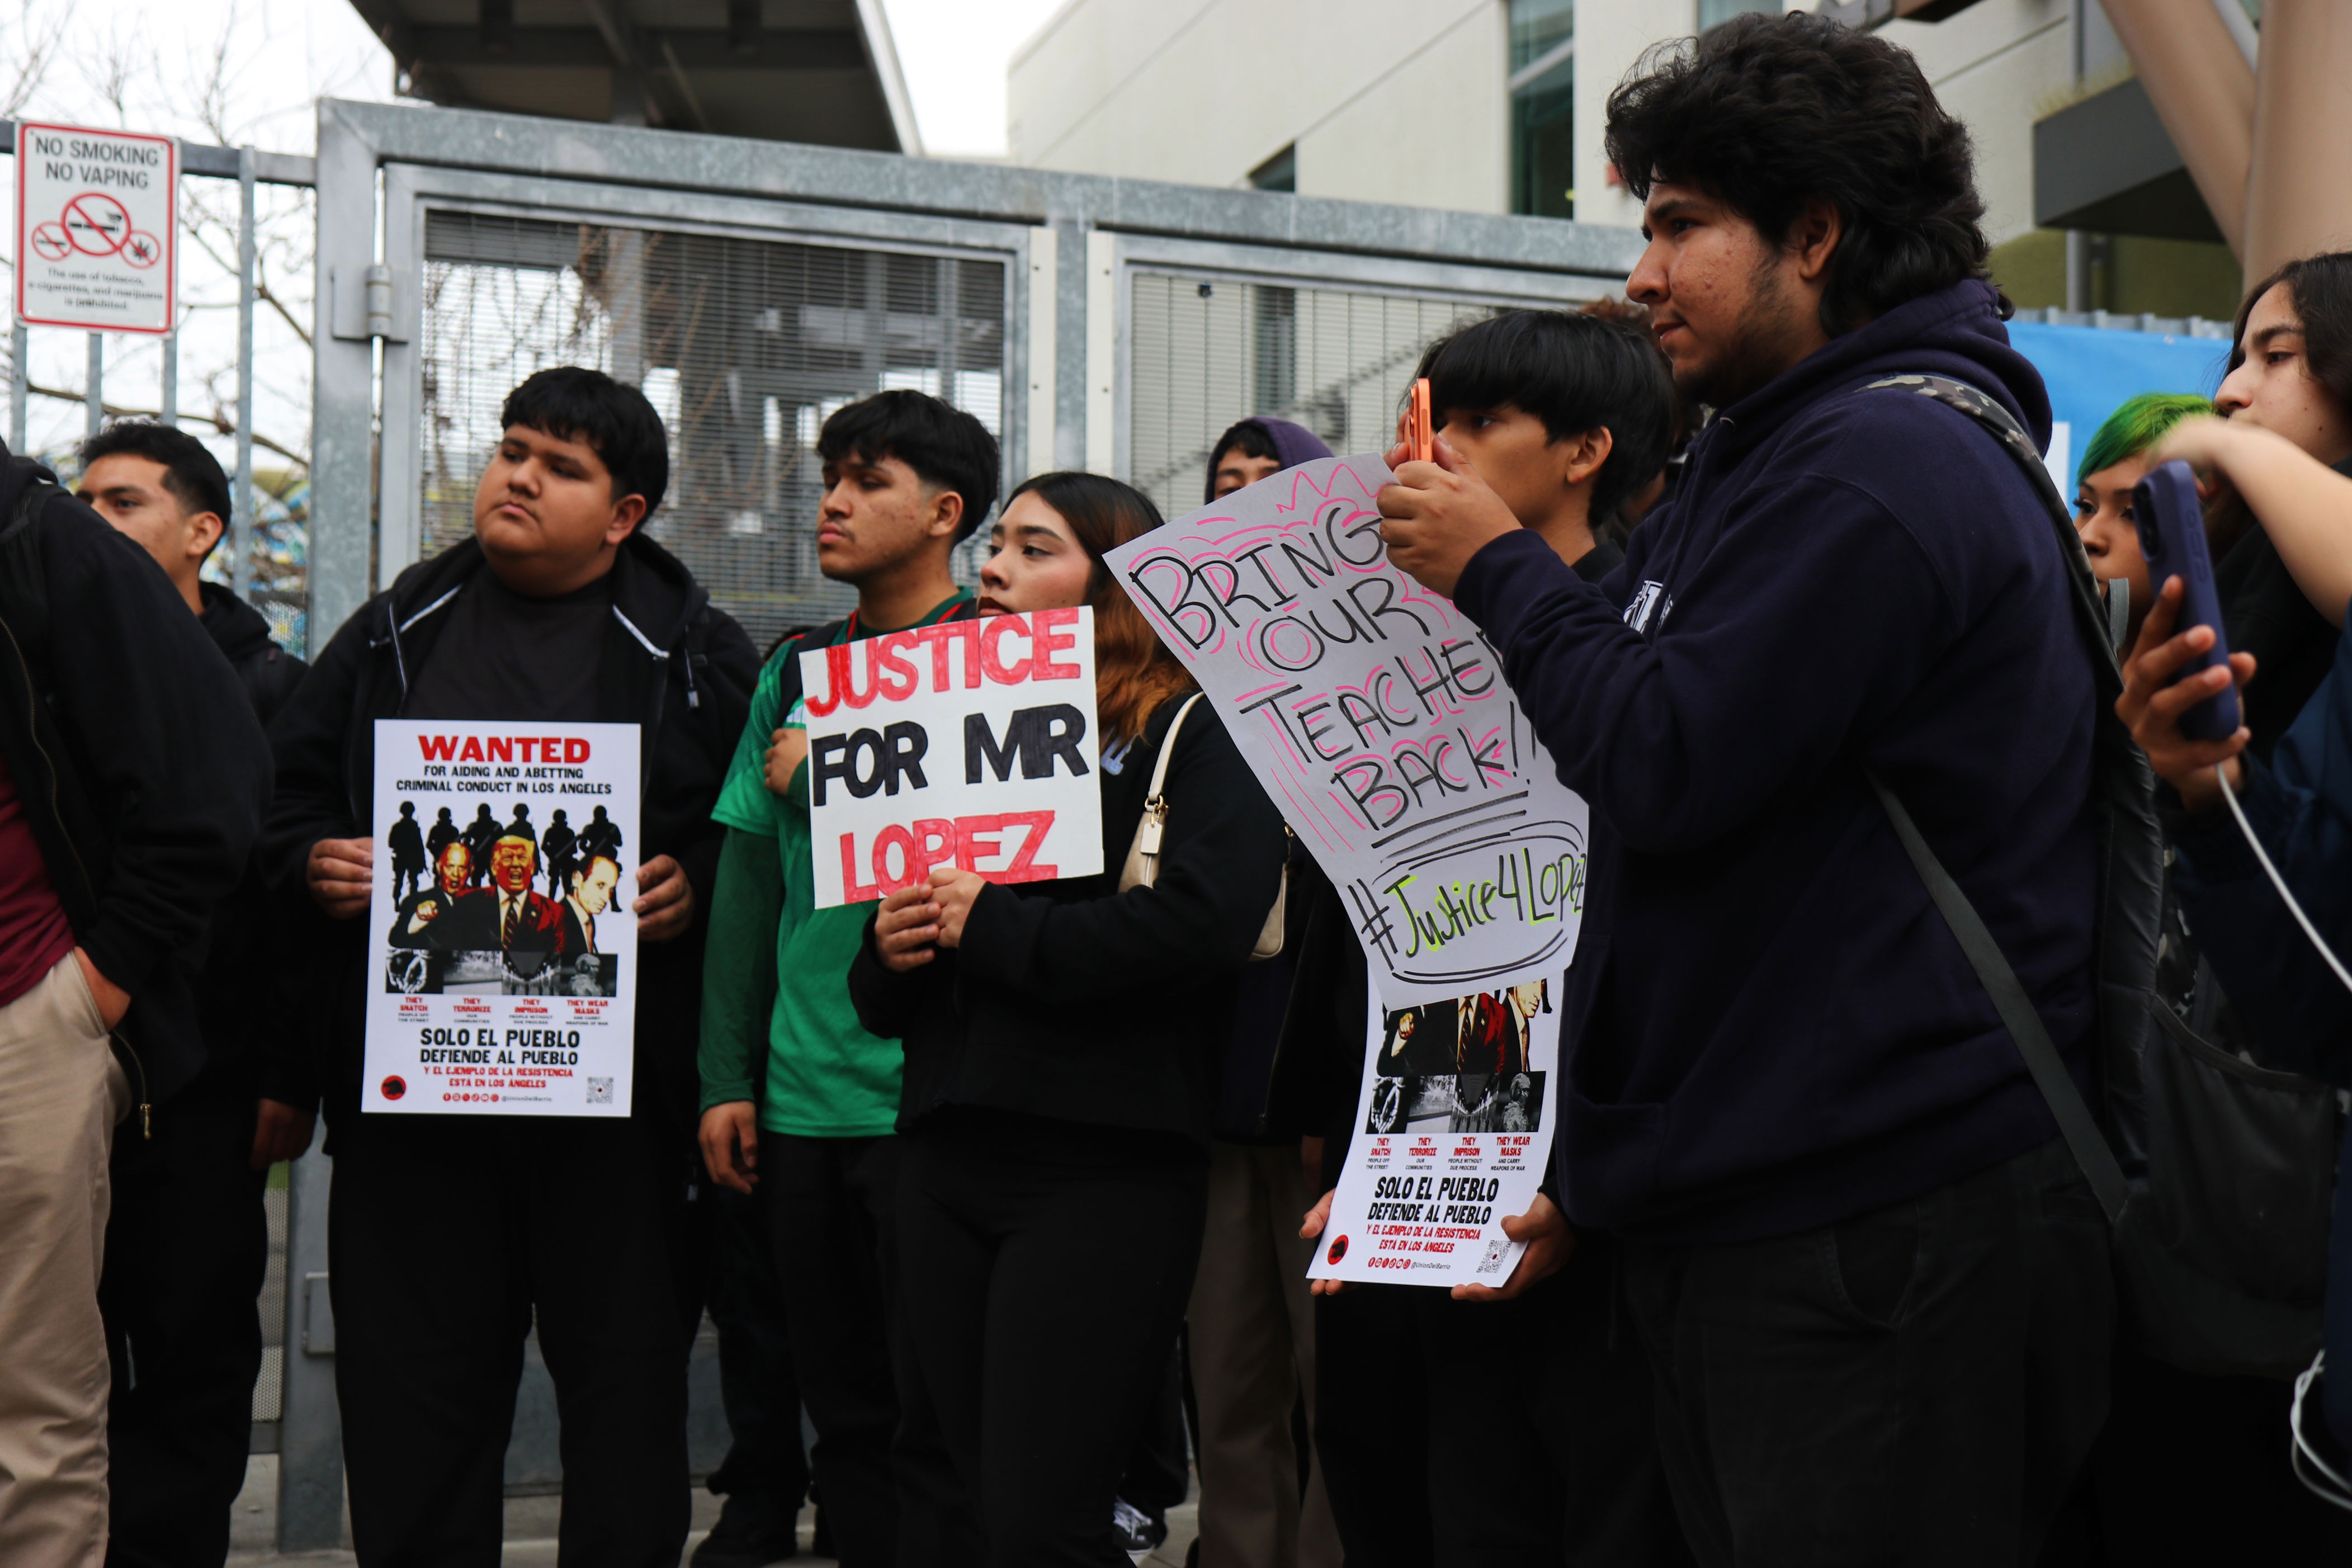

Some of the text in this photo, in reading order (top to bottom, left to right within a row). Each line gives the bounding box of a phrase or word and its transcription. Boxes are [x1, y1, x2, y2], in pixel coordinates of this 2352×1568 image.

[36, 137, 158, 167] NO SMOKING
[46, 162, 149, 189] NO VAPING
[1128, 507, 1383, 649] BRING
[1260, 578, 1430, 671] OUR
[804, 606, 1080, 717] JUSTICE
[418, 734, 591, 764] WANTED
[811, 721, 928, 806] FOR
[964, 703, 1089, 785] MR
[424, 766, 583, 778] FOR AIDING AND ABETTING
[396, 780, 611, 795] CRIMINAL CONDUCT IN LOS ANGELES
[839, 810, 1057, 904] LOPEZ
[421, 1028, 580, 1048] SOLO EL PUEBLO
[421, 1049, 578, 1065] DEFIENDE AL PUEBLO
[424, 1066, 573, 1077] Y EL EJEMPLO DE LA RESISTENCIA
[449, 1077, 471, 1087] ESTÁ
[475, 1079, 485, 1087] EN
[488, 1079, 504, 1087] LOS
[1377, 1137, 1390, 1146] THEY
[1418, 1137, 1432, 1146] THEY
[1462, 1137, 1476, 1146] THEY
[1496, 1136, 1531, 1145] THEY WEAR
[1409, 1147, 1437, 1156] TERRORIZE
[1453, 1147, 1480, 1156] IMPRISON
[1500, 1147, 1522, 1156] MASKS
[1375, 1177, 1499, 1202] SOLO EL PUEBLO
[1367, 1202, 1491, 1225] DEFIENDE AL PUEBLO
[1366, 1224, 1481, 1240] Y EL EJEMPLO DE LA RESISTENCIA
[1378, 1238, 1454, 1253] ESTÁ EN LOS ÁNGELES
[1411, 1260, 1451, 1270] @UnionDelBarrio
